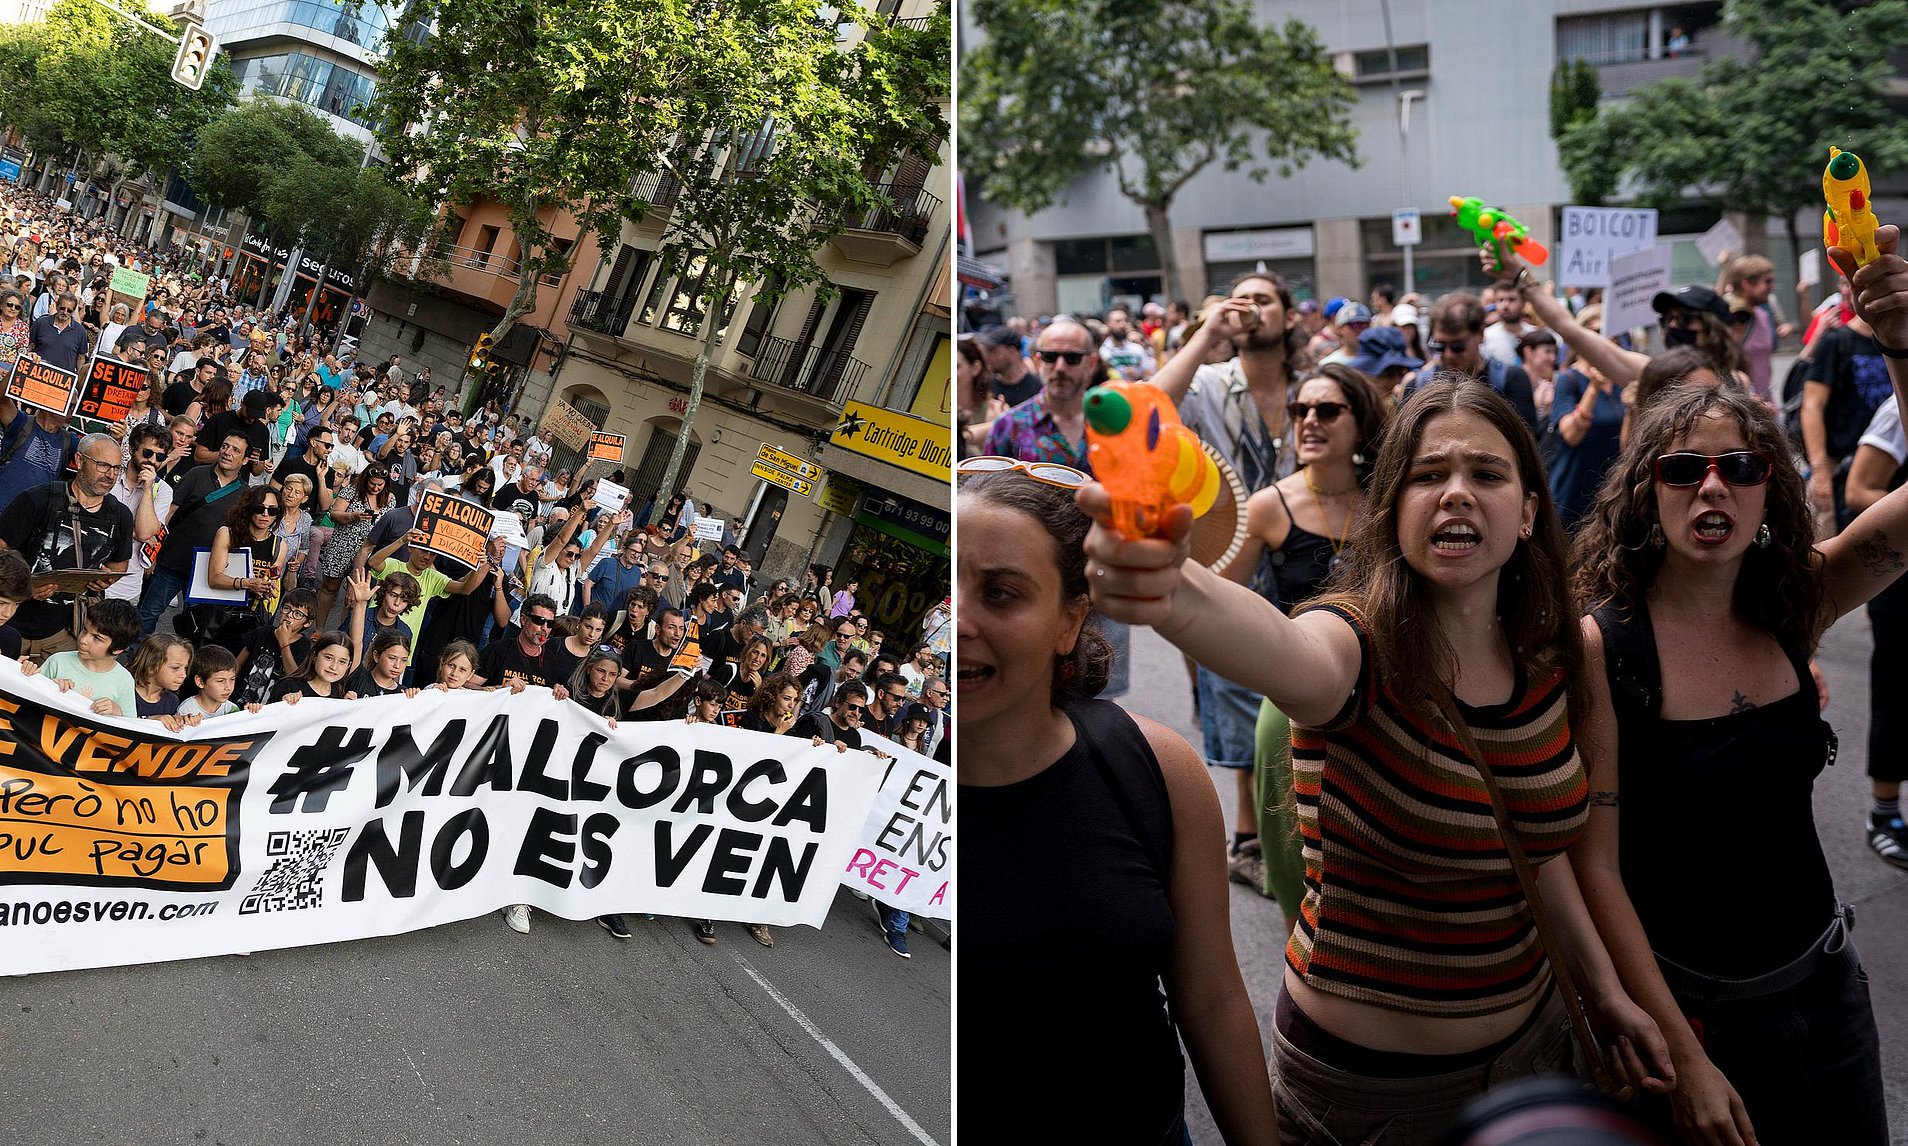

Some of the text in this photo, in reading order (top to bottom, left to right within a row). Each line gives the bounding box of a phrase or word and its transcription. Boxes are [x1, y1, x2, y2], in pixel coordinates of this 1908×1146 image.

[1568, 211, 1648, 239] BOICOT
[17, 360, 72, 390] SE ALQUILA
[93, 362, 115, 382] SE
[597, 434, 623, 446] ALQUILA
[864, 422, 918, 458] Cartridge
[769, 453, 780, 463] San
[780, 457, 799, 471] Miguel
[423, 495, 444, 514] SE
[443, 500, 492, 534] ALQUILA
[905, 509, 918, 522] 93
[919, 514, 934, 528] 99
[935, 520, 950, 534] 00
[504, 669, 546, 686] MALLRCA
[40, 714, 254, 779] VENDE
[266, 714, 827, 833] #MALLORCA
[0, 778, 219, 832] Però no ho
[88, 840, 208, 876] pagar
[341, 806, 819, 903] NO ES VEN
[845, 848, 949, 906] RET A
